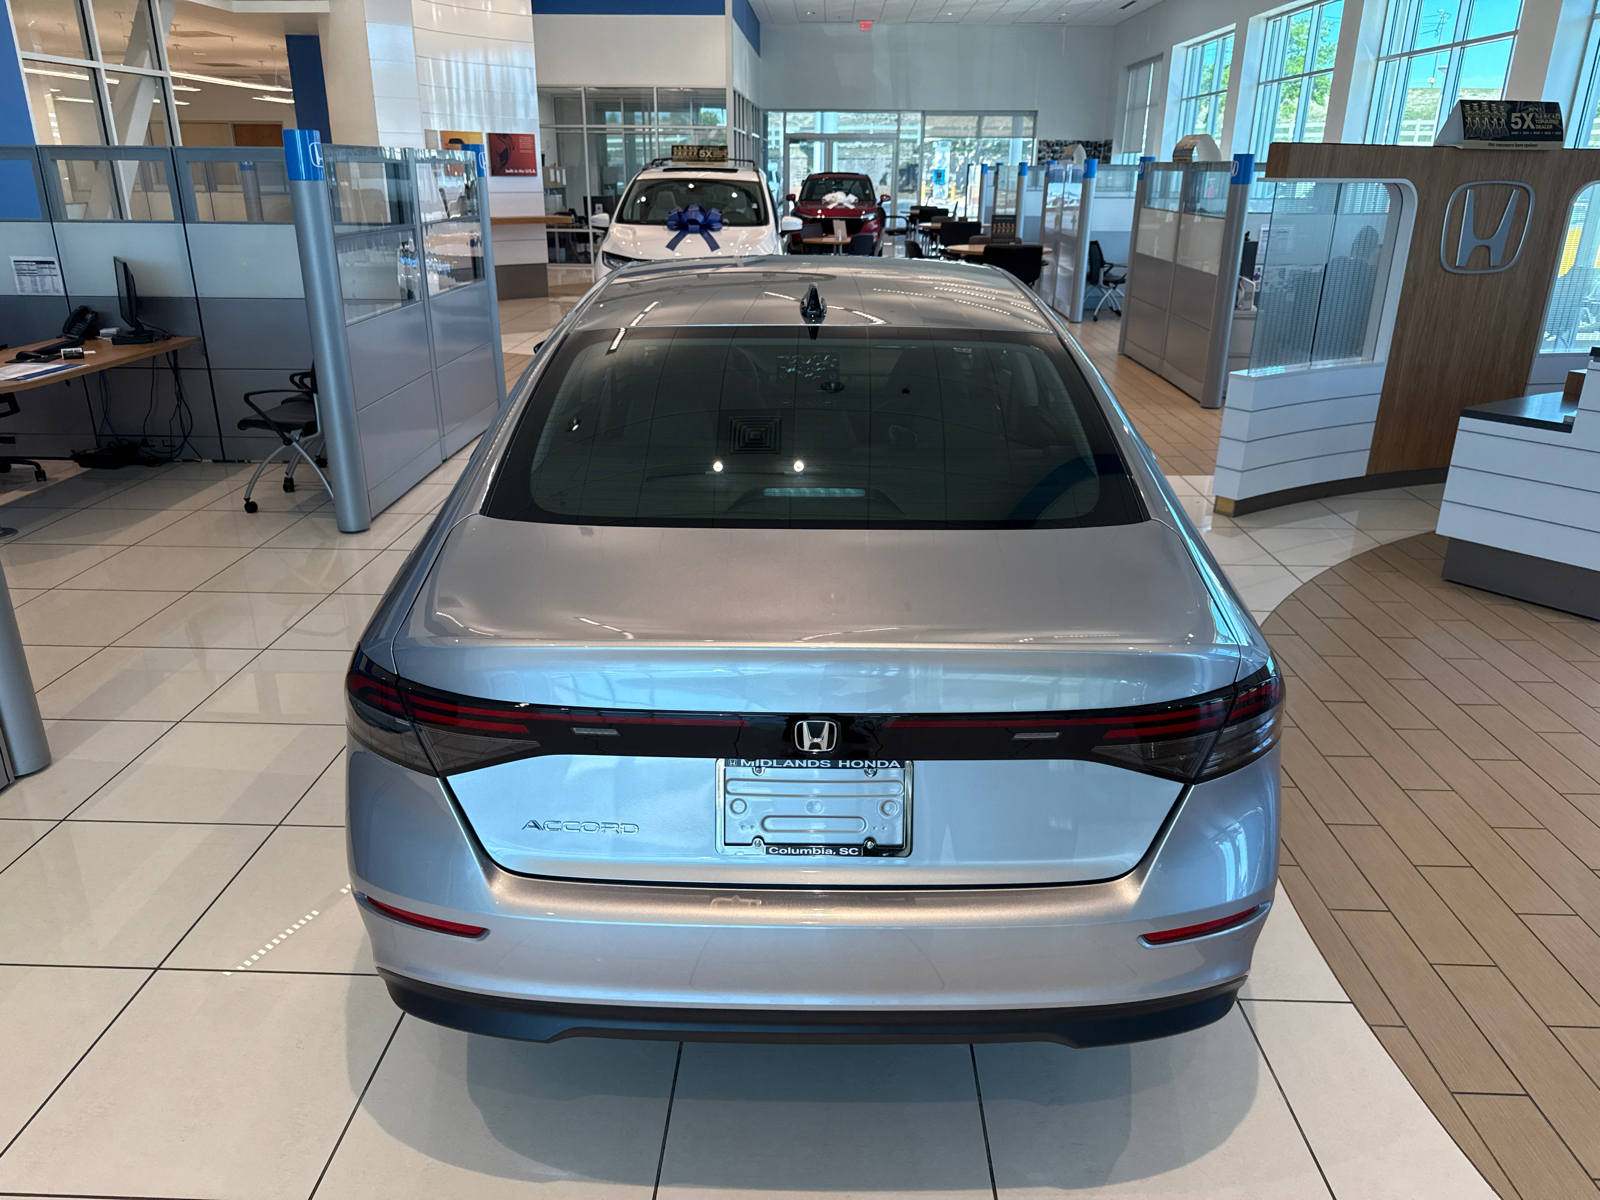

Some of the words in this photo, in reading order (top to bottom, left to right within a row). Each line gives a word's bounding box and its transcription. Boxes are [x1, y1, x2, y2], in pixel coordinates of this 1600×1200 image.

[1510, 112, 1535, 129] 5X
[699, 149, 712, 158] 5X
[740, 759, 831, 768] MIDLANDS
[838, 759, 901, 768] HONDA
[521, 819, 640, 835] ACCORD
[768, 846, 836, 856] Columbia,
[839, 847, 859, 856] SC
